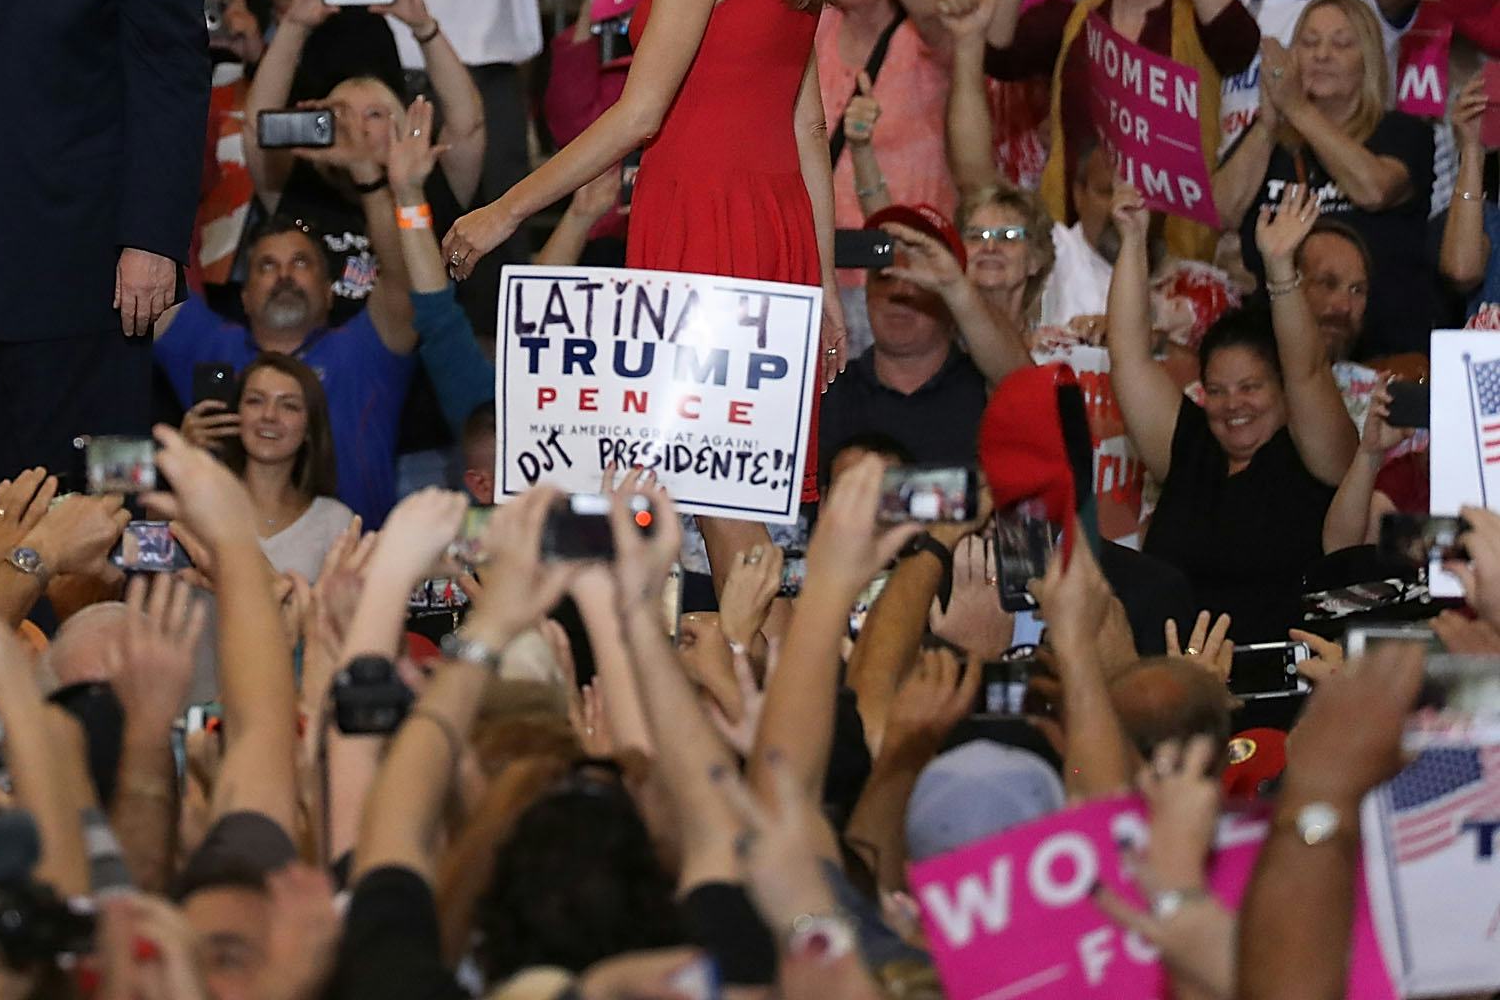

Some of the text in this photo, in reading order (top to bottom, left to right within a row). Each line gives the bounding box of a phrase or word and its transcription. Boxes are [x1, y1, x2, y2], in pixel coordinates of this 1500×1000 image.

[1086, 18, 1199, 120] WOMEN
[1110, 99, 1150, 147] FOR
[737, 296, 771, 348] 4
[519, 337, 789, 391] TRUMP
[537, 387, 754, 425] PENCE
[517, 430, 573, 487] DJT
[571, 424, 632, 437] AMERICA
[701, 434, 760, 449] AGAIN!
